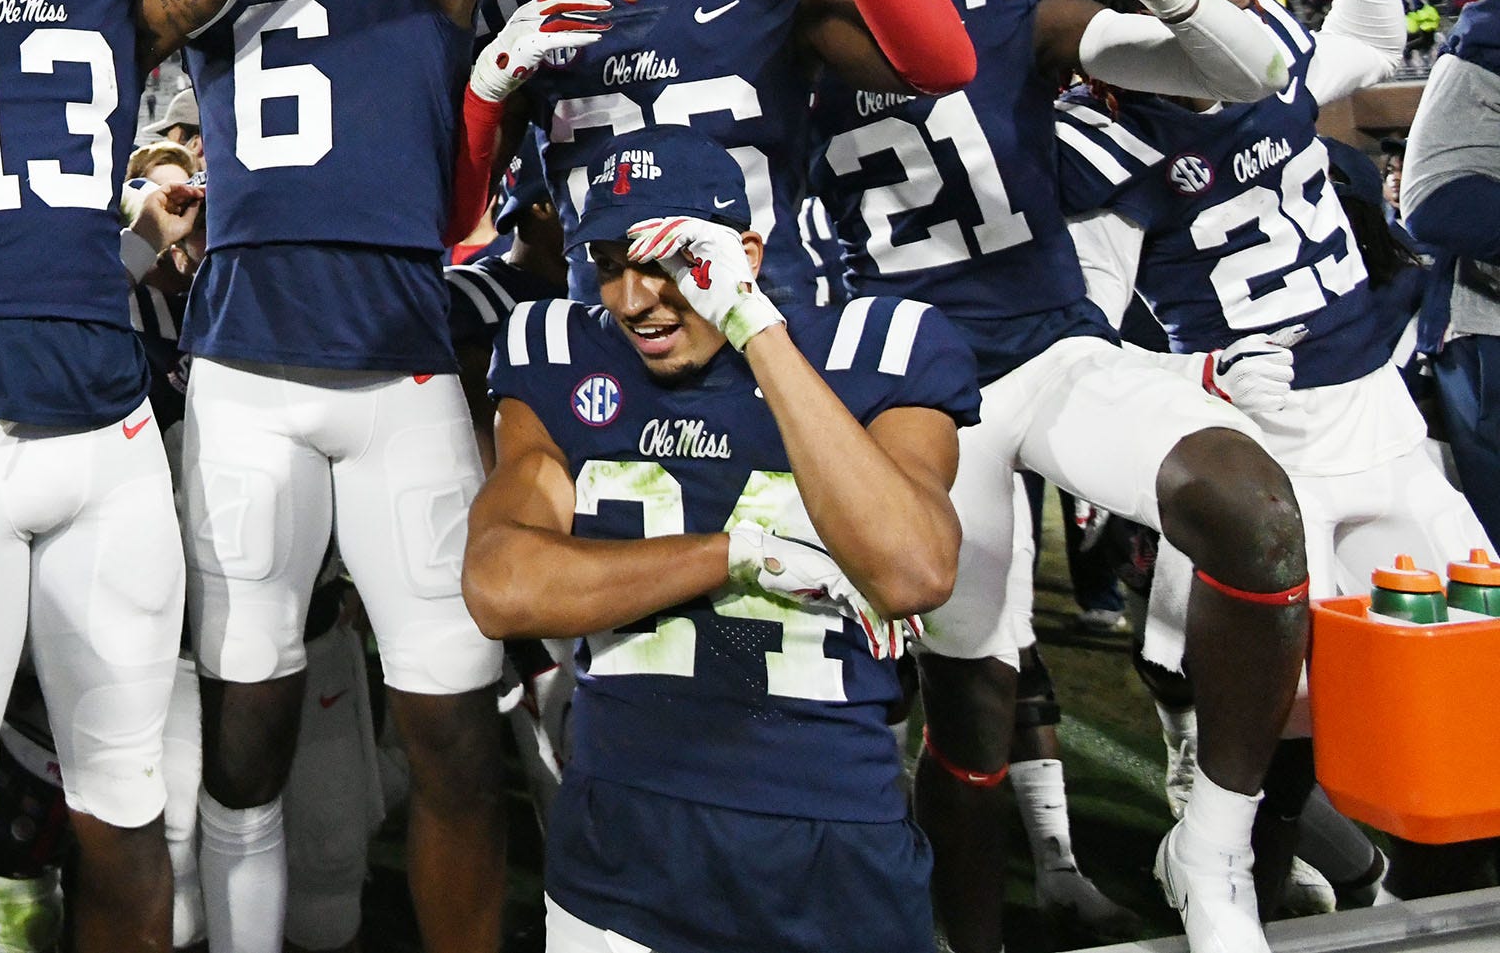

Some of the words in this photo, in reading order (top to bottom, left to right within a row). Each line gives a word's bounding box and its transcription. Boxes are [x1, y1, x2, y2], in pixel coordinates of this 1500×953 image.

[602, 55, 632, 86] Ole
[630, 50, 681, 82] Miss
[591, 168, 615, 186] THE
[631, 162, 663, 181] SIP
[603, 152, 617, 171] WE
[619, 149, 655, 166] RUN
[826, 90, 1034, 274] 21
[1170, 155, 1211, 193] SEC
[1232, 150, 1259, 184] Ole
[1255, 136, 1292, 171] Miss
[1190, 137, 1369, 330] 29
[574, 377, 620, 423] SEC
[638, 418, 677, 459] Ole
[674, 421, 732, 460] Miss
[573, 459, 848, 702] 24
